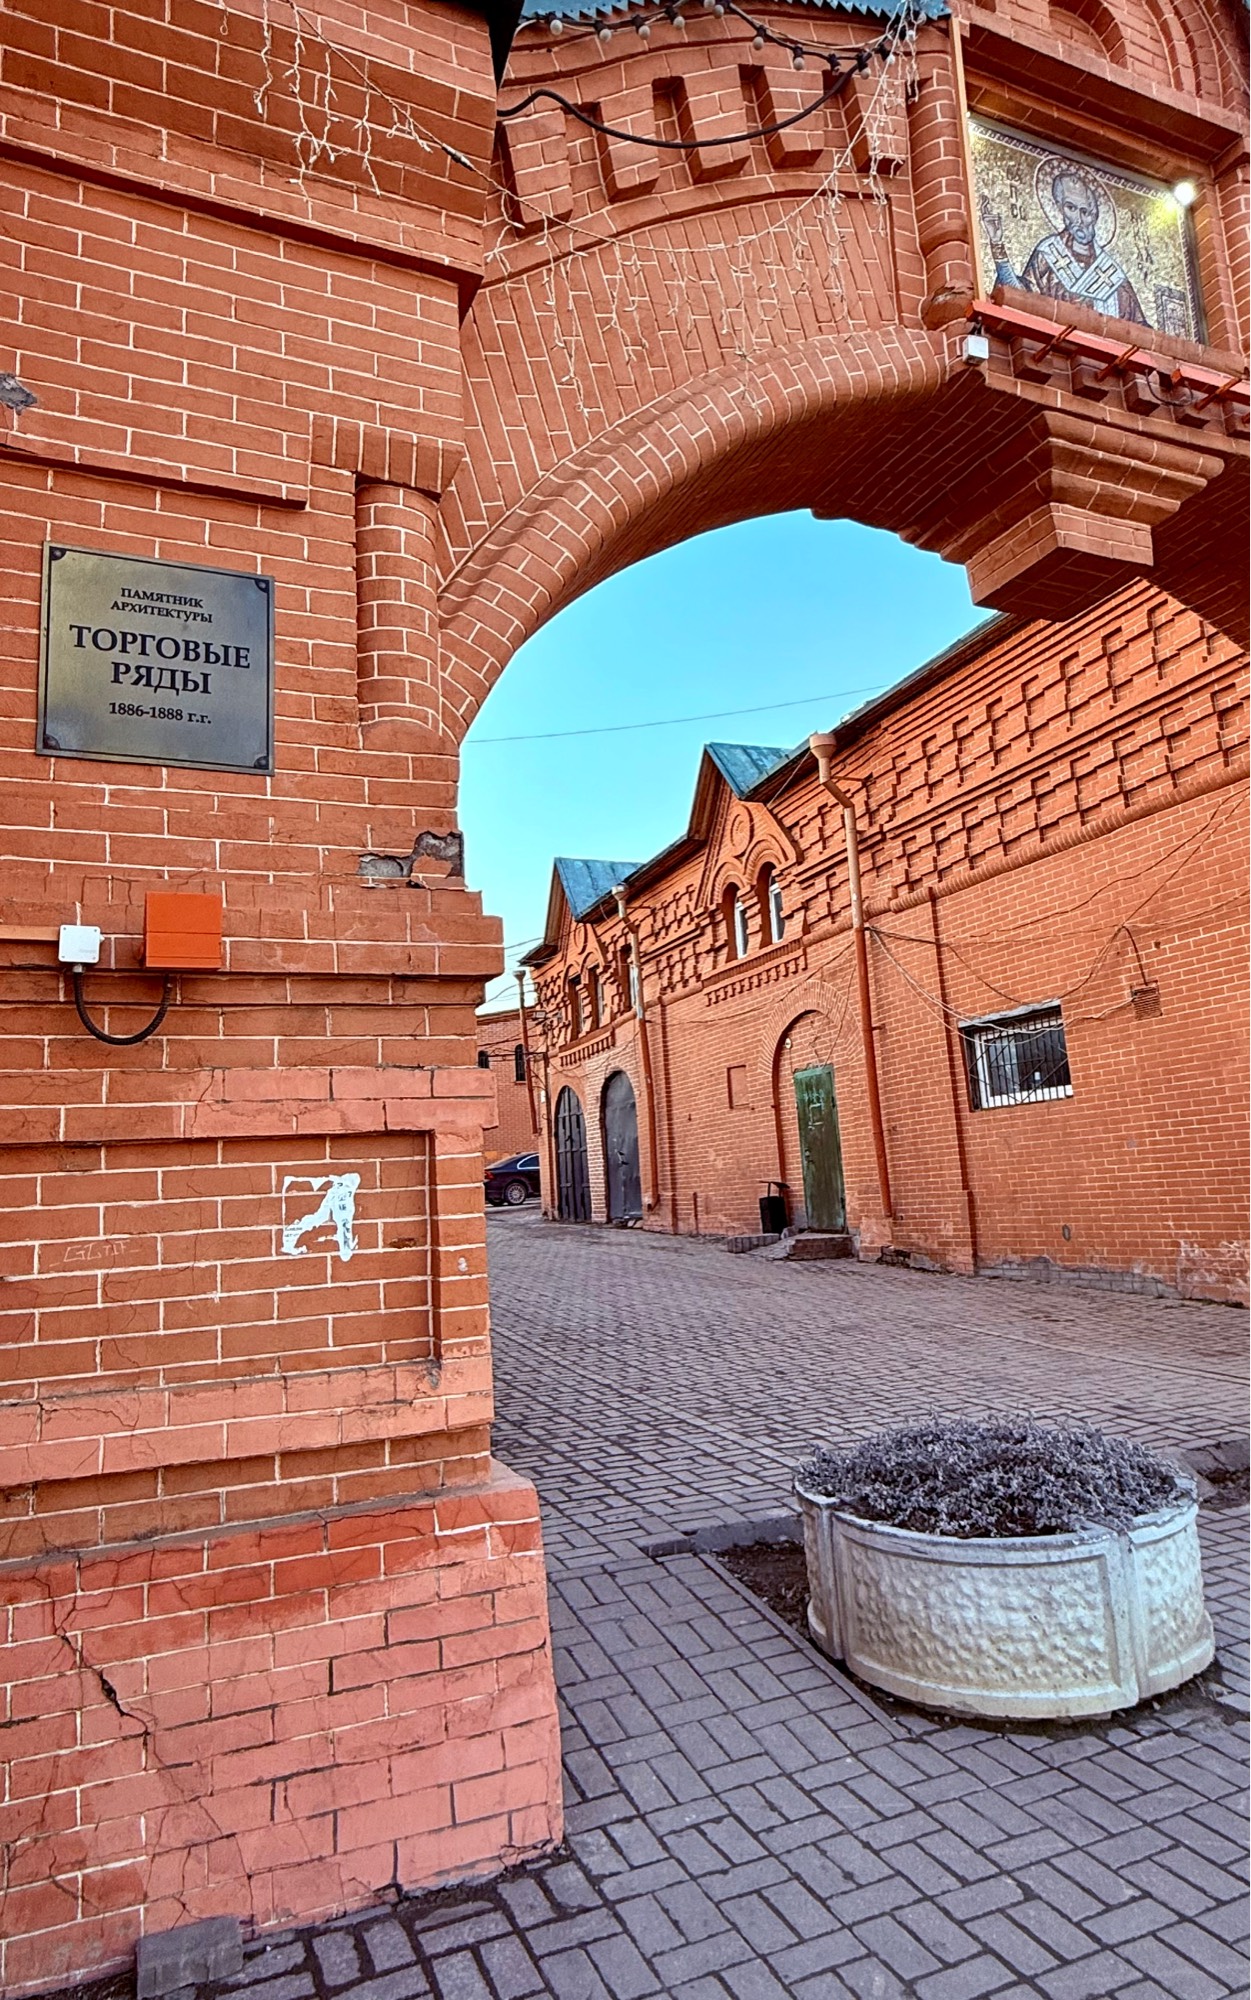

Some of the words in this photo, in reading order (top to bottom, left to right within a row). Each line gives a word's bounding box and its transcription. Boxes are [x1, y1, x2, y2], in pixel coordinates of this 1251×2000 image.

[120, 587, 204, 609] ПАМЯТНИК
[110, 600, 213, 624] АРХИТЕКТУРЫ
[69, 624, 251, 669] ТОРГОВЫЕ
[110, 661, 212, 696] РЯДЫ
[108, 702, 183, 721] 1886-1888
[187, 713, 212, 724] г.г.
